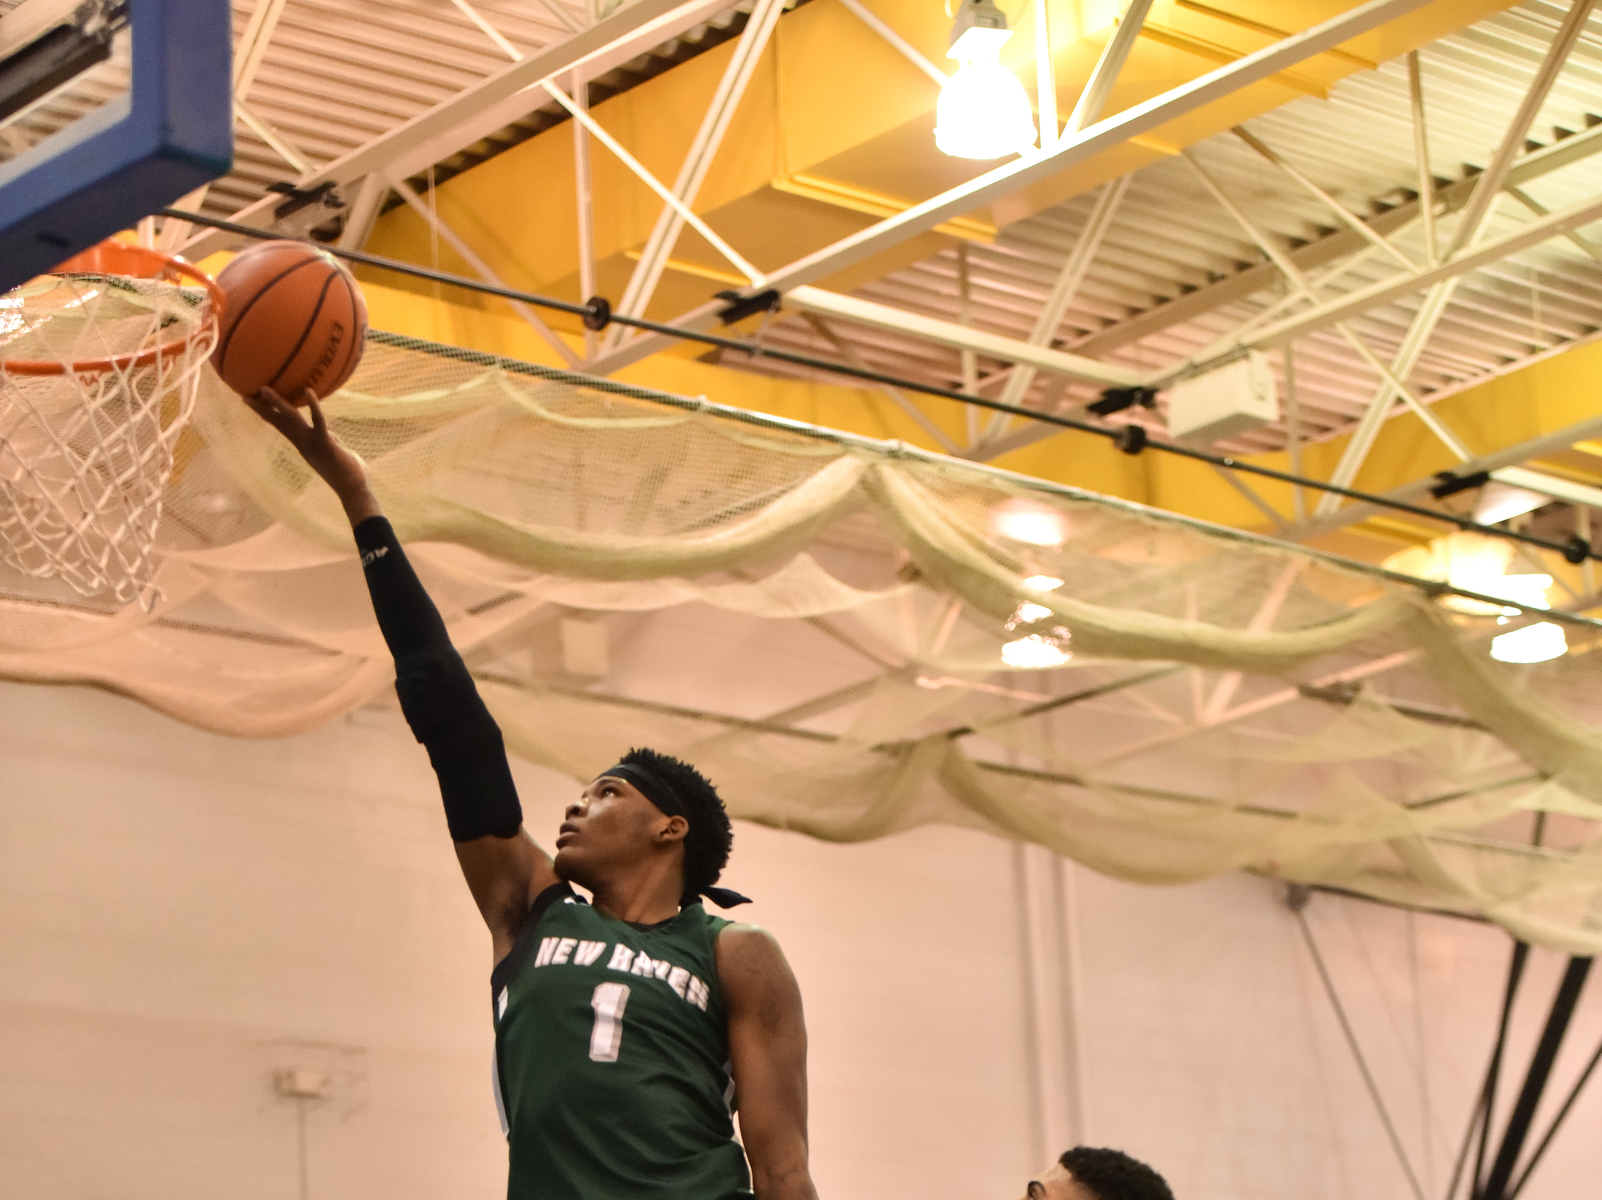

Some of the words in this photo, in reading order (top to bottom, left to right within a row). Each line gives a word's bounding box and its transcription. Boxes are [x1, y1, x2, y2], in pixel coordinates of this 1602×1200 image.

[534, 936, 607, 968] NEW
[607, 943, 710, 1012] HAVEN
[589, 982, 631, 1062] 1
